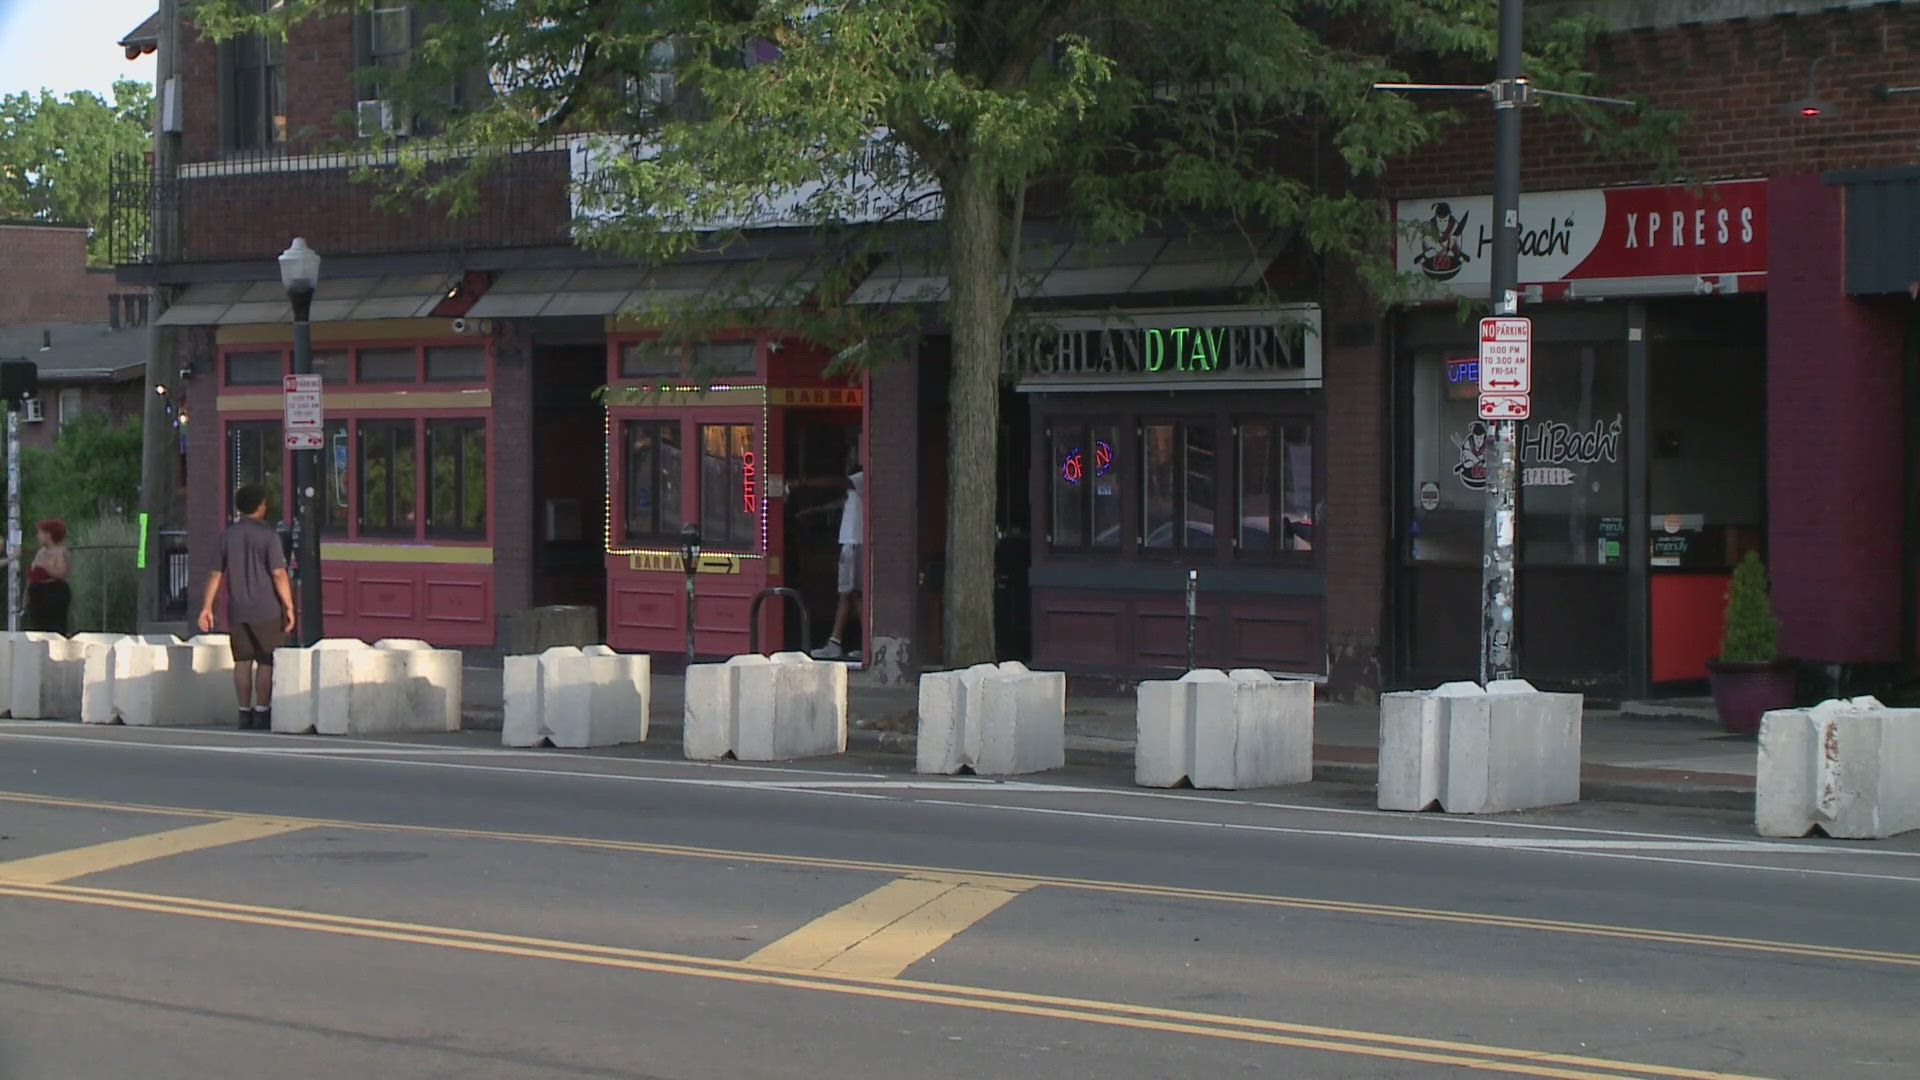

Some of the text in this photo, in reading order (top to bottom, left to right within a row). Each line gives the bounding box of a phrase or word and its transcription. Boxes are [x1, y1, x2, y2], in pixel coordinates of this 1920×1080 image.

[1626, 206, 1753, 249] XPRESS
[1482, 324, 1526, 337] NO PARKING
[1509, 346, 1519, 354] PM
[1448, 362, 1479, 382] OPE
[1491, 367, 1517, 375] FRI-SAT
[1520, 413, 1622, 464] HiBachi
[743, 451, 756, 513] OPEN
